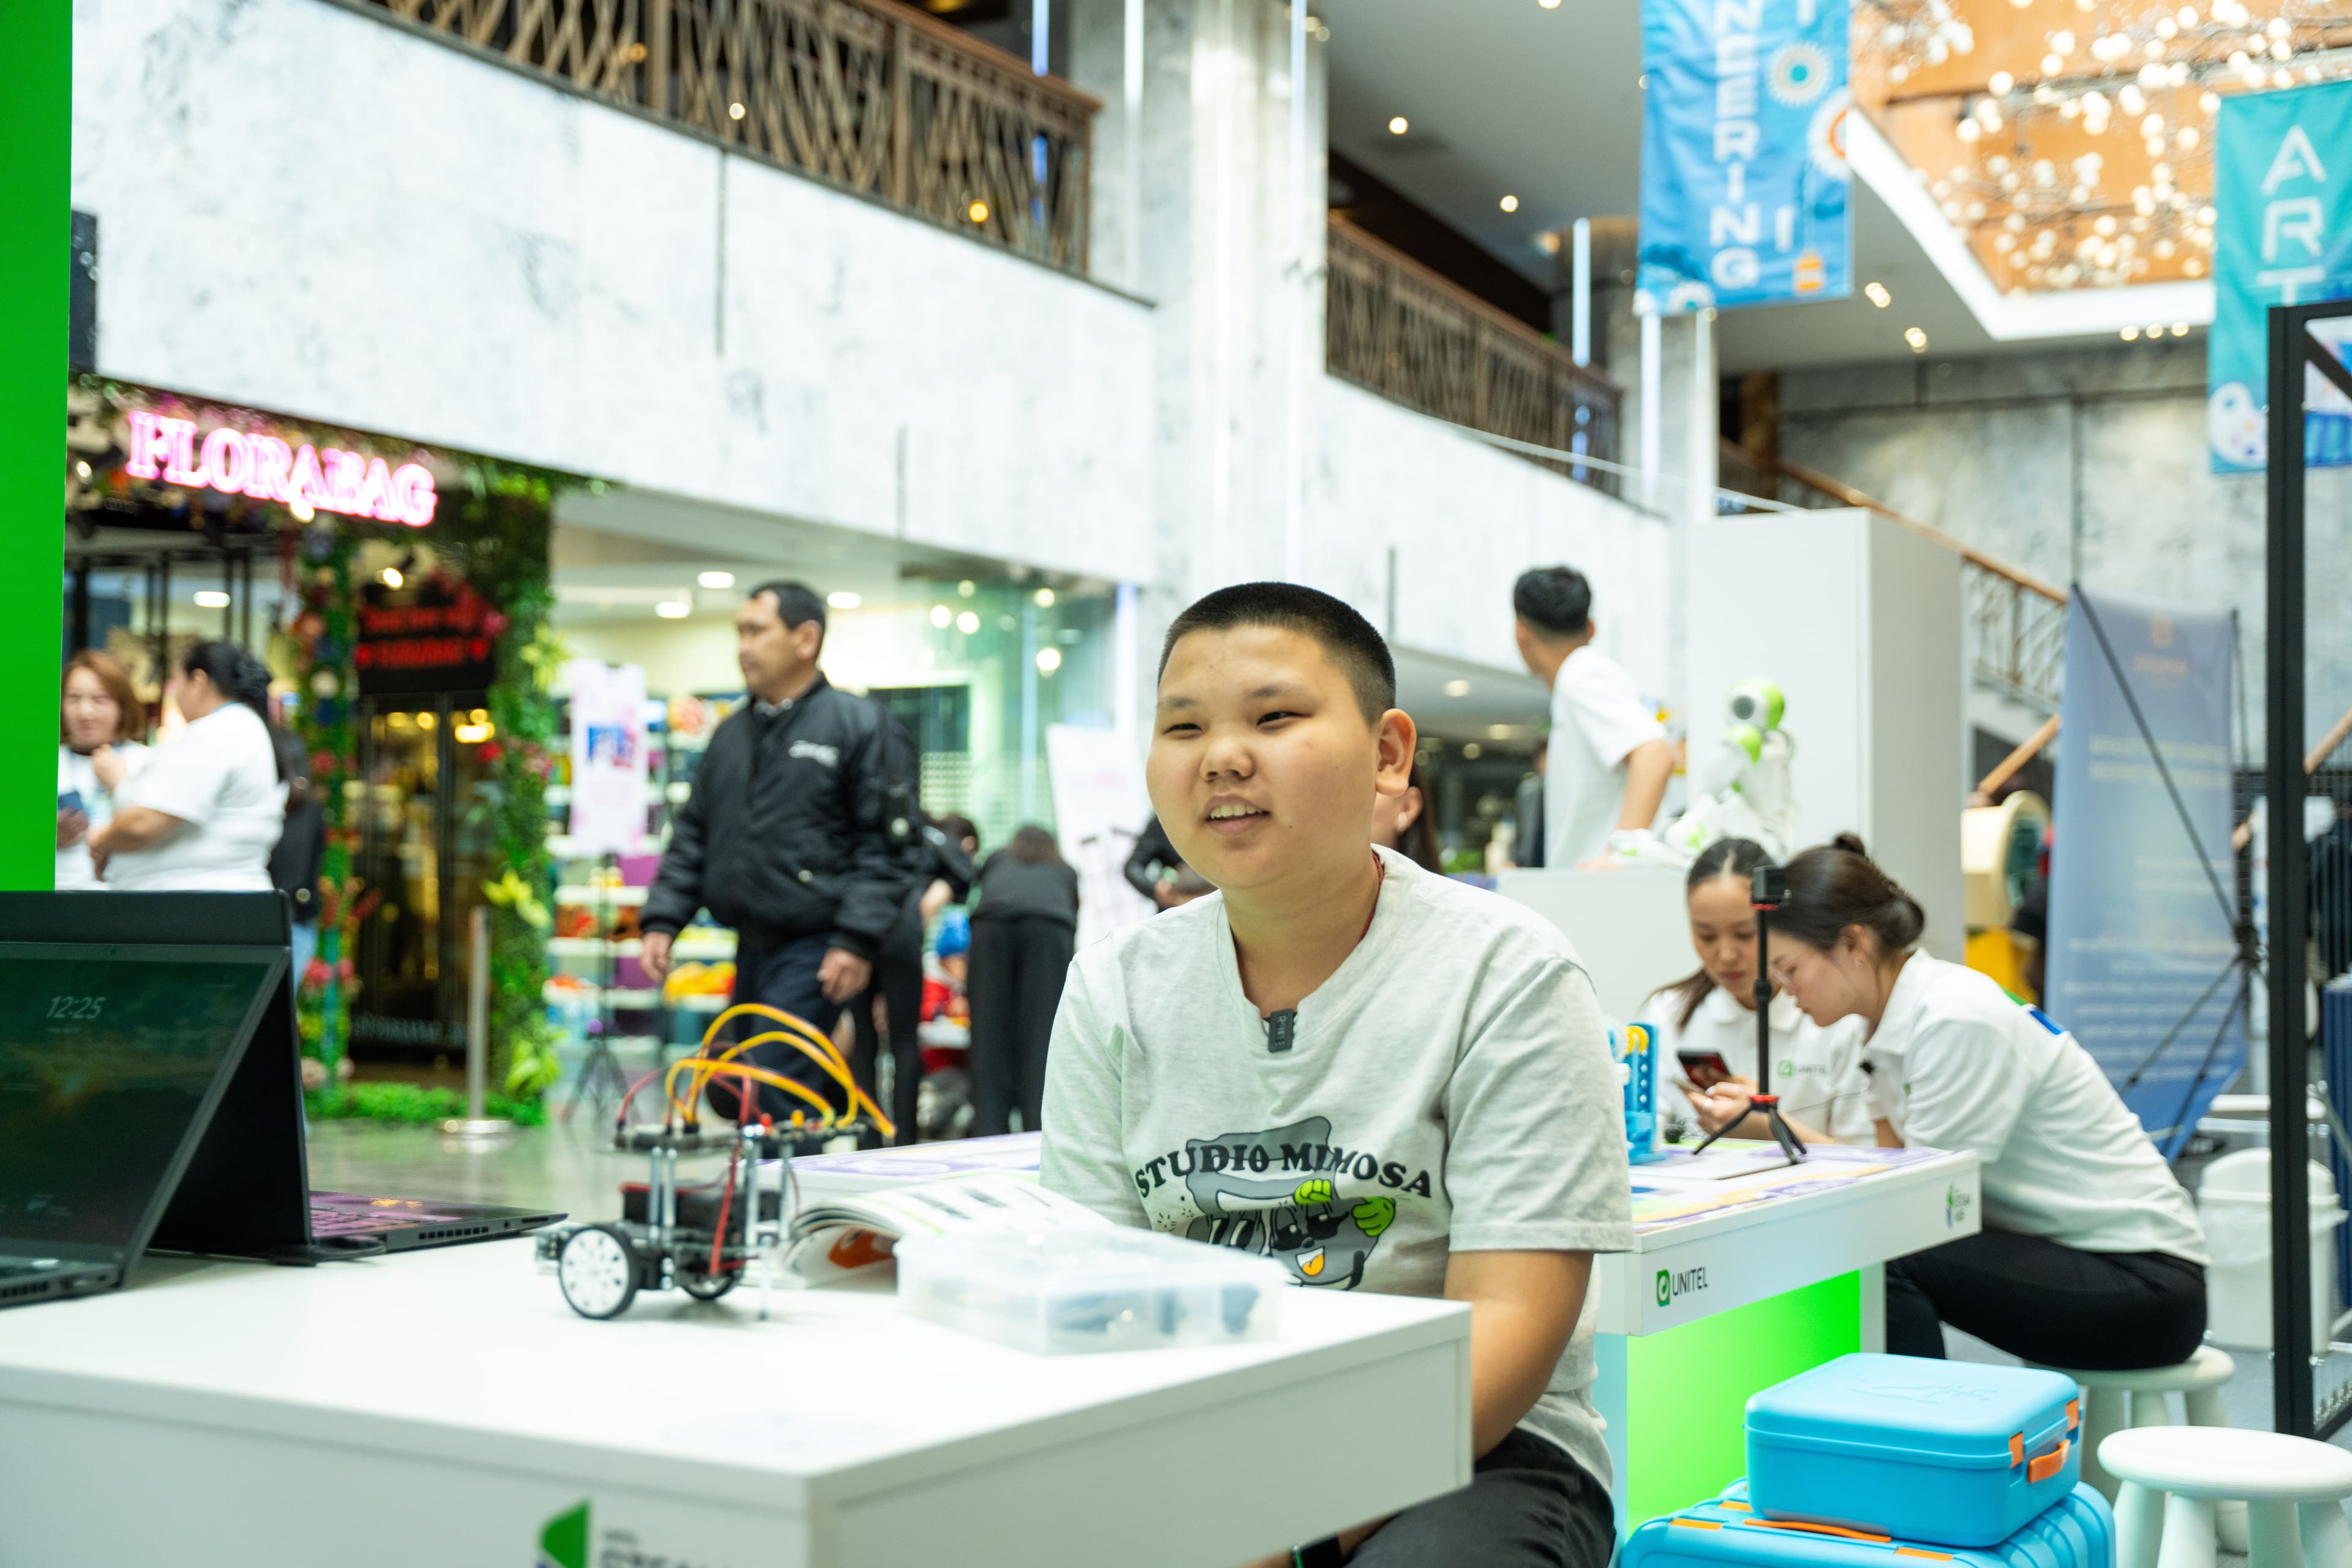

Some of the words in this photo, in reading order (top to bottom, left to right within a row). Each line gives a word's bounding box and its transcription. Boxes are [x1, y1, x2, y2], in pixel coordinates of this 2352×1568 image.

[2256, 125, 2326, 306] ART
[126, 410, 438, 527] FLORABAG
[47, 996, 107, 1020] 12:25
[1134, 1144, 1270, 1198] STUDIO
[1280, 1142, 1432, 1198] MIMOSA
[1672, 1265, 1708, 1296] UNITEL
